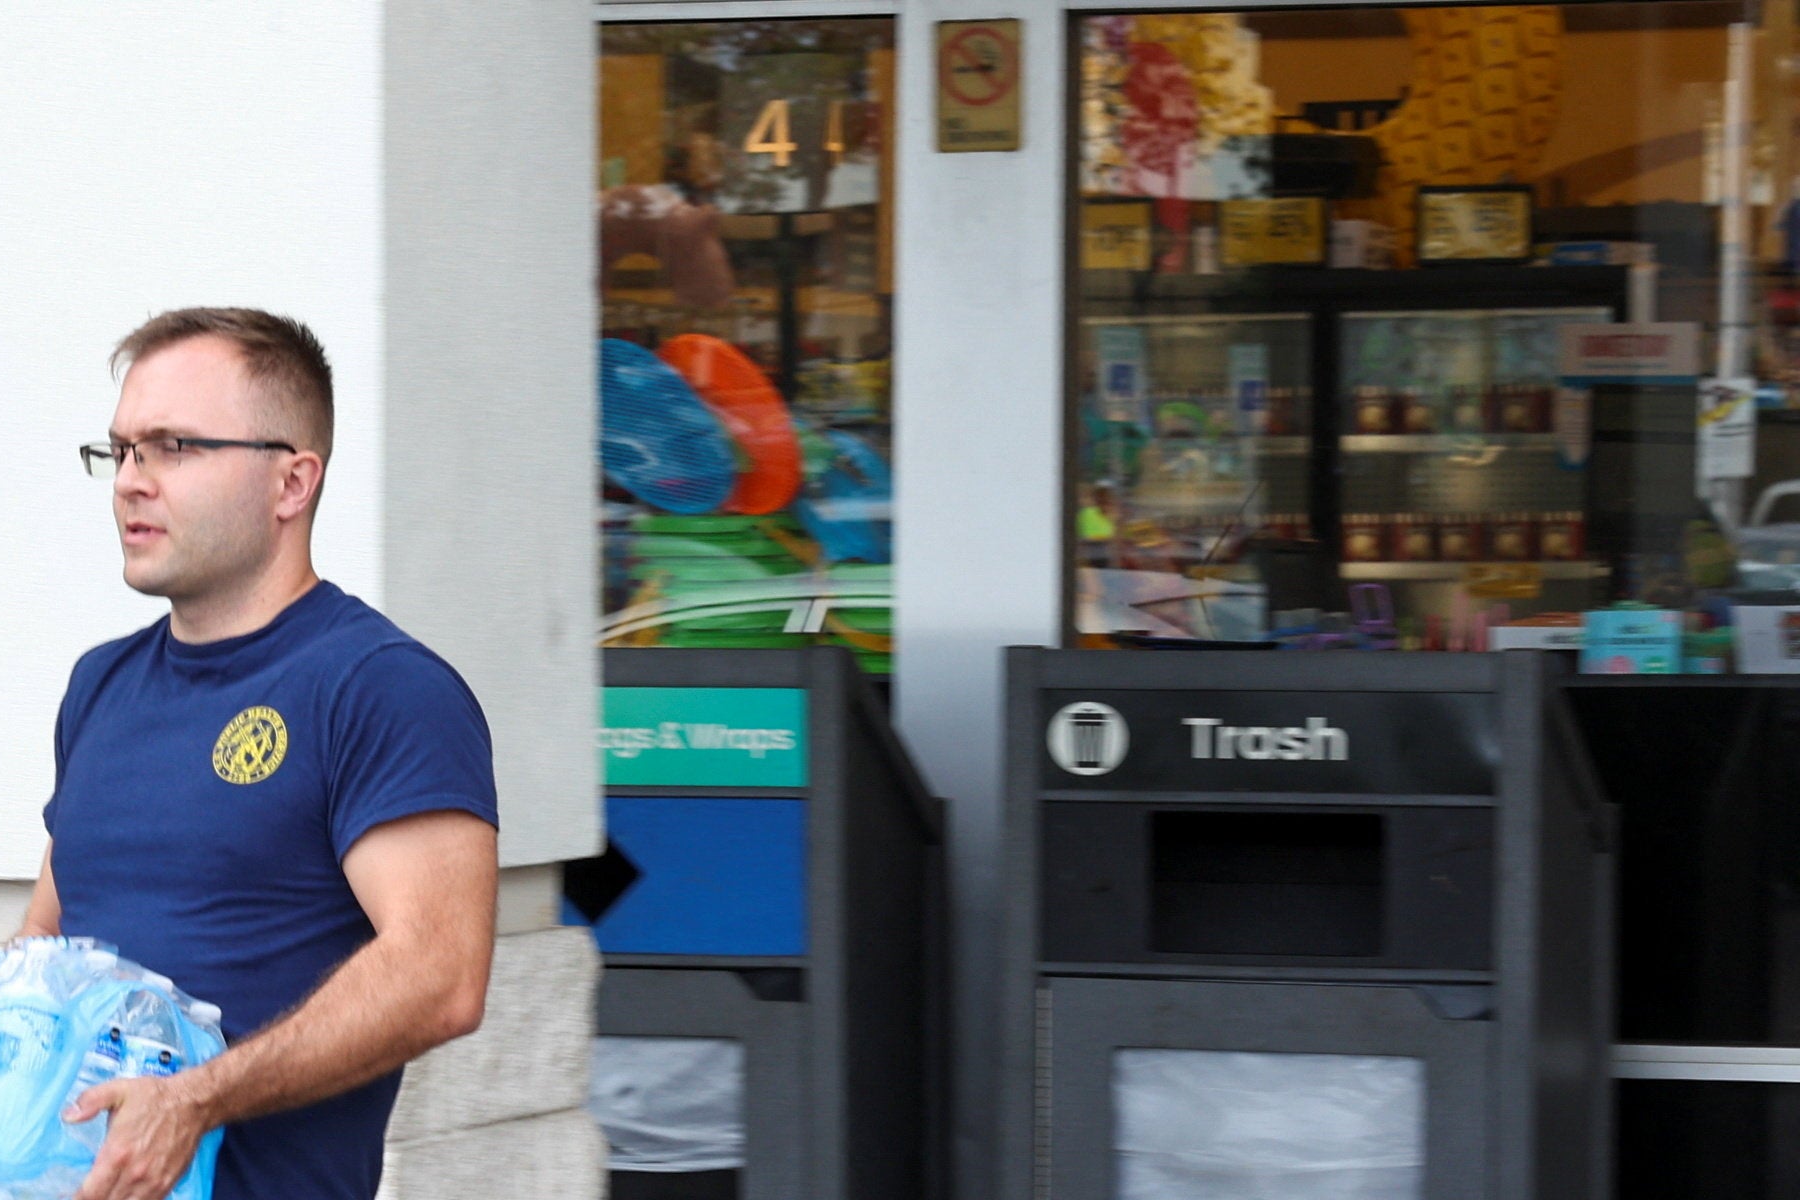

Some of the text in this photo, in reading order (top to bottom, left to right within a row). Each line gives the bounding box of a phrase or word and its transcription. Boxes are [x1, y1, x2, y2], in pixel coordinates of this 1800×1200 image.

[743, 99, 799, 167] 4
[658, 721, 686, 749] &
[686, 723, 796, 759] Wraps
[1181, 717, 1349, 761] Trash
